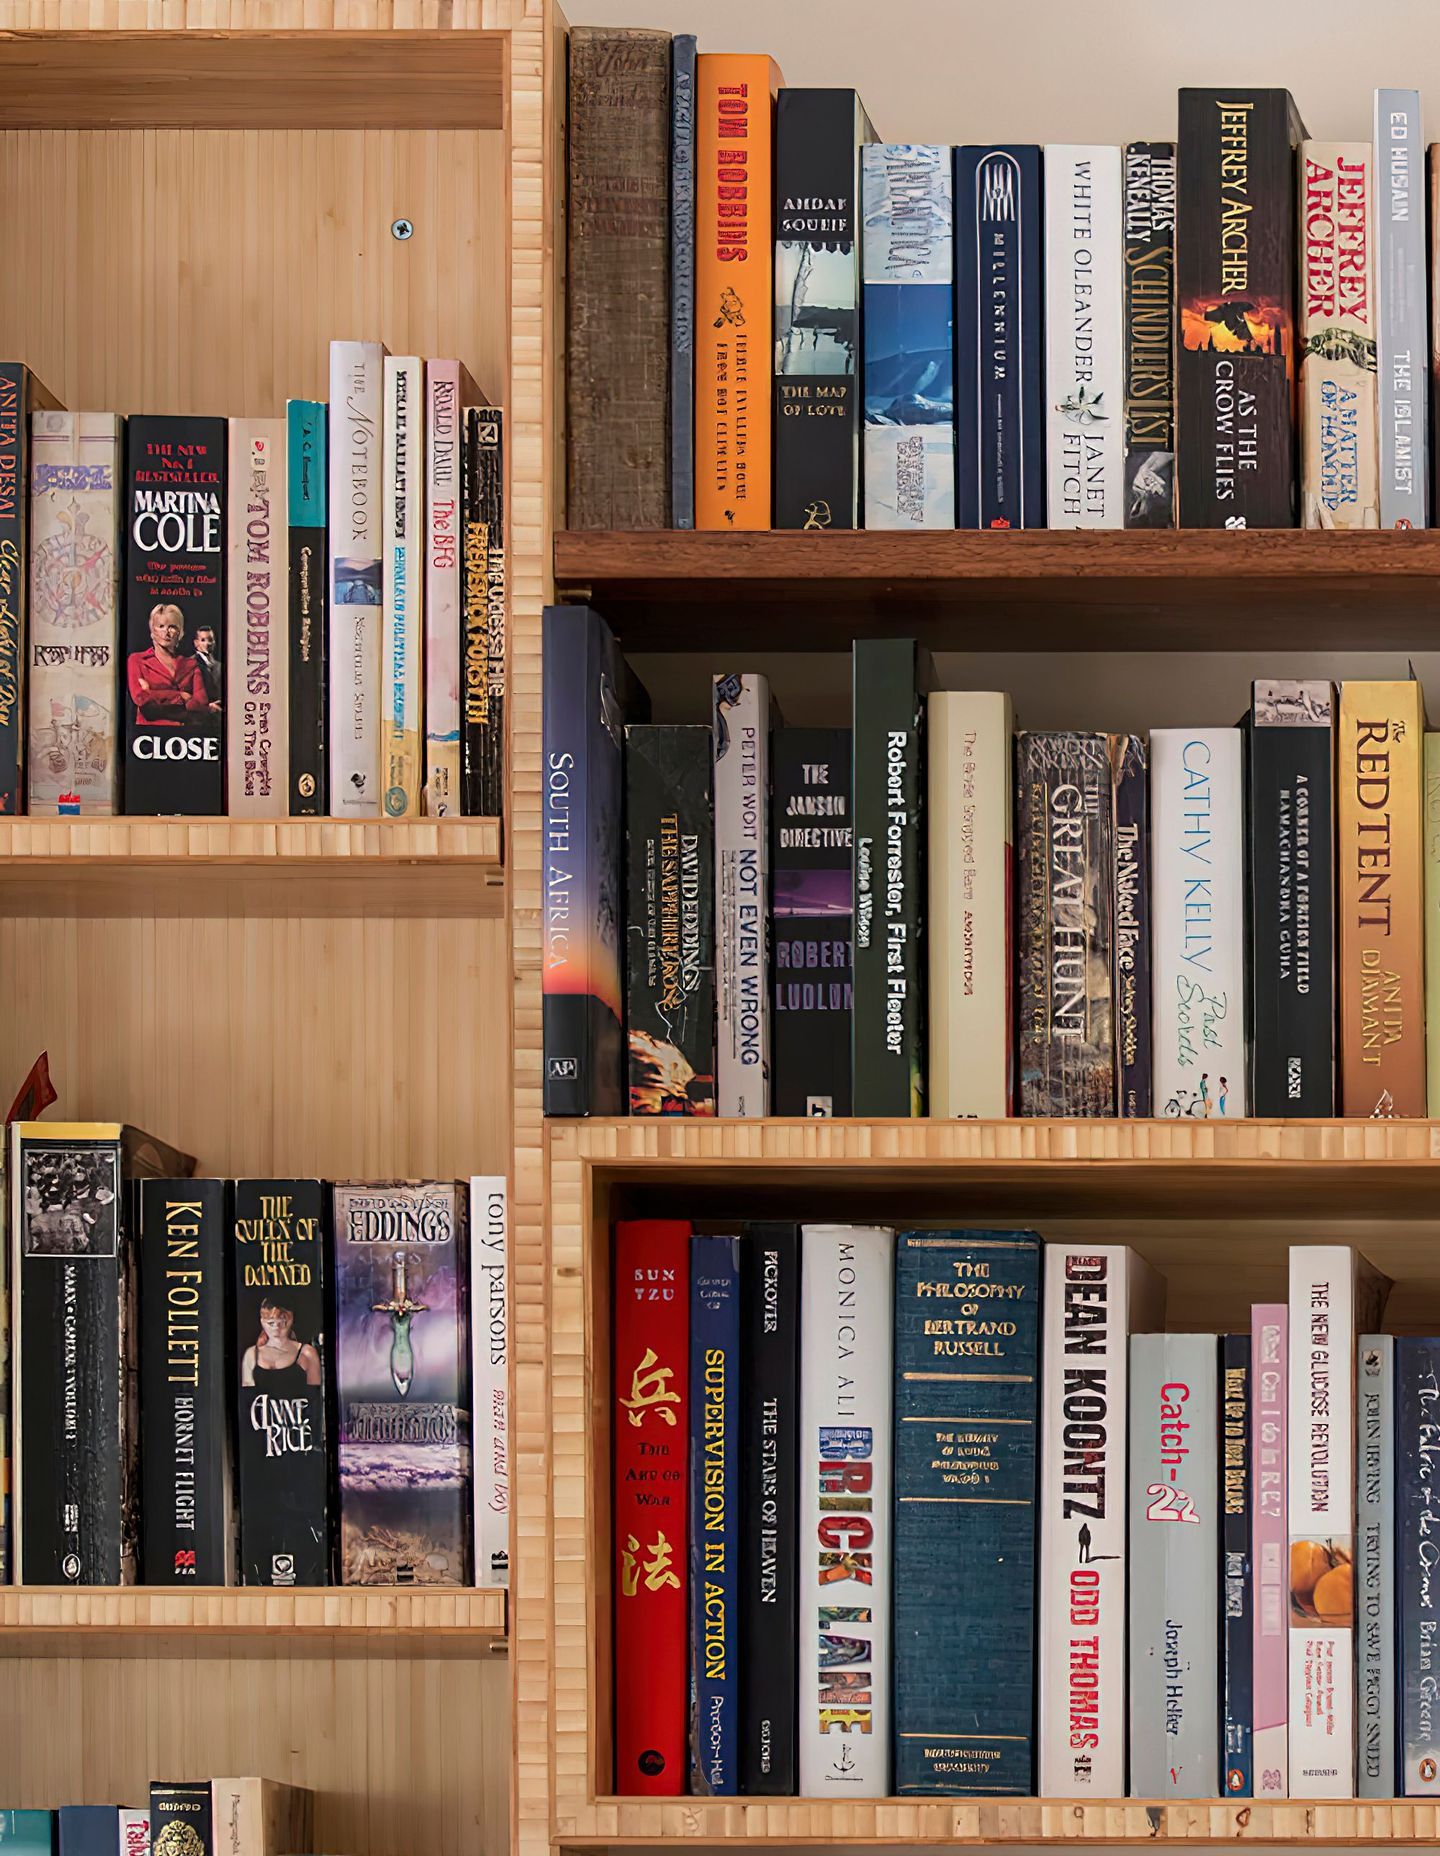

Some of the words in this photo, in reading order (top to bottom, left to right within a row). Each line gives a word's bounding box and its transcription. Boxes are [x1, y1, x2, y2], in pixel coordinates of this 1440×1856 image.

[718, 84, 747, 138] TOM
[1391, 113, 1407, 141] ED
[717, 150, 747, 262] ROBBINS
[1073, 161, 1091, 239] WHITE
[1127, 153, 1151, 242] KENEALLY
[1150, 155, 1174, 230] THOMAS
[1391, 148, 1408, 221] HUSAIN
[1306, 159, 1334, 318] ARCHER
[1337, 157, 1367, 324] JEFFREY
[1074, 250, 1093, 383] OLEANDER
[1215, 360, 1234, 434] CROW
[1237, 390, 1255, 416] AS
[1393, 350, 1410, 390] THE
[1063, 433, 1082, 515] FITCH
[1084, 434, 1105, 518] JANET
[1215, 443, 1233, 500] FLIES
[1238, 424, 1256, 470] THE
[1338, 407, 1358, 504] MATTER
[133, 514, 220, 552] COLE
[134, 491, 220, 513] MARTINA
[246, 500, 270, 564] TOM
[433, 500, 454, 530] The
[432, 534, 454, 568] BFG
[247, 571, 271, 694] ROBBINS
[133, 736, 219, 760] CLOSE
[741, 727, 756, 788] PETER
[1356, 718, 1390, 810] RED
[550, 753, 575, 851] SOUTH
[1179, 740, 1211, 864] CATHY
[739, 850, 758, 895] NOT
[1117, 823, 1138, 859] The
[1359, 813, 1392, 936] TENT
[549, 866, 573, 970] AFRICA
[1117, 861, 1138, 925] Naked
[1180, 879, 1213, 971] KELLY
[740, 906, 759, 967] EVEN
[1119, 927, 1138, 972] Face
[740, 975, 760, 1066] WRONG
[1360, 950, 1381, 1067] DIAMANT
[1383, 970, 1402, 1045] ANITA
[166, 1202, 202, 1257] KEN
[486, 1193, 506, 1252] tony
[838, 1243, 857, 1360] MONICA
[954, 1262, 989, 1277] THE
[1065, 1255, 1108, 1355] DEAN
[167, 1270, 202, 1386] FOLLETT
[482, 1264, 507, 1365] parsons
[174, 1397, 194, 1463] HORNET
[762, 1399, 777, 1435] THE
[838, 1376, 855, 1417] ALI
[705, 1350, 724, 1531] SUPERVISION
[1064, 1369, 1108, 1520] KOONTZ
[175, 1472, 194, 1530] FLIGHT
[762, 1500, 777, 1525] OF
[818, 1426, 873, 1587] BRICK
[706, 1542, 724, 1571] IN
[761, 1529, 777, 1603] HEAVEN
[706, 1581, 725, 1680] ACTION
[1071, 1570, 1101, 1625] ODD
[818, 1606, 873, 1735] LANE
[1069, 1635, 1100, 1749] THOMAS
